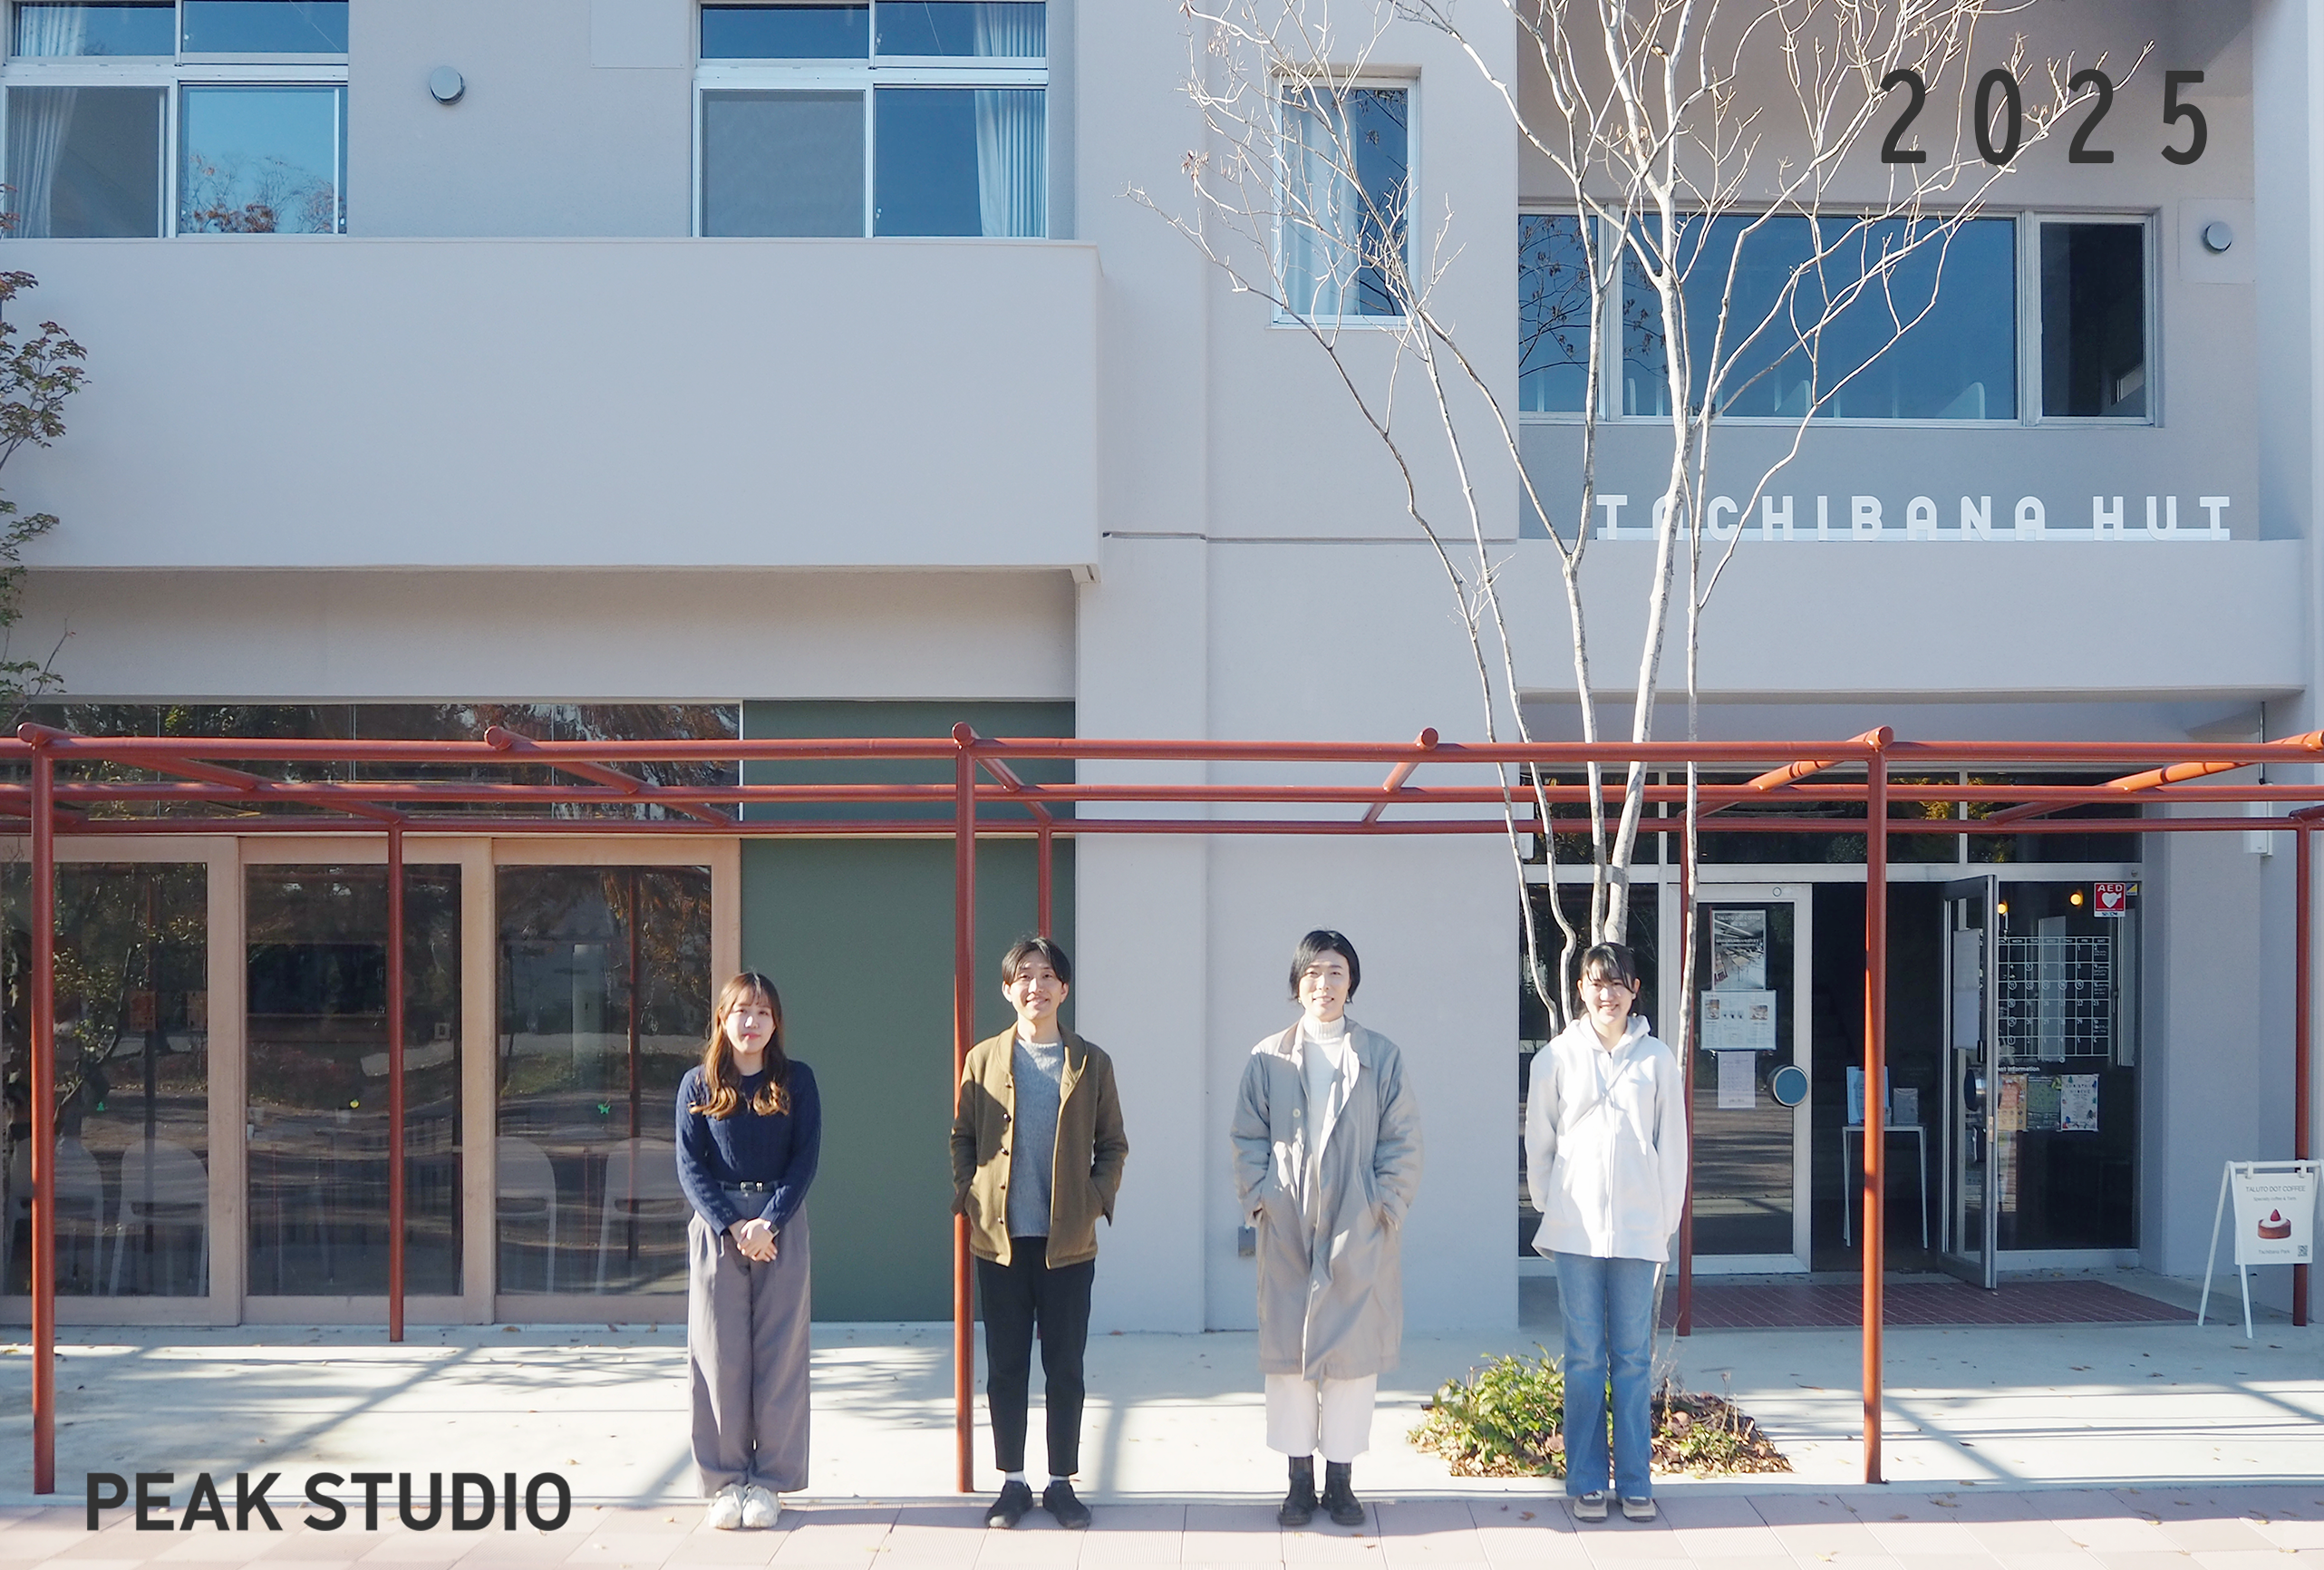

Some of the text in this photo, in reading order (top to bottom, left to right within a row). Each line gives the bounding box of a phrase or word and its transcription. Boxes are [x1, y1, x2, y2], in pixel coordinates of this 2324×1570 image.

[1596, 494, 2230, 541] TACHIBANA HUT
[2097, 884, 2123, 892] AED
